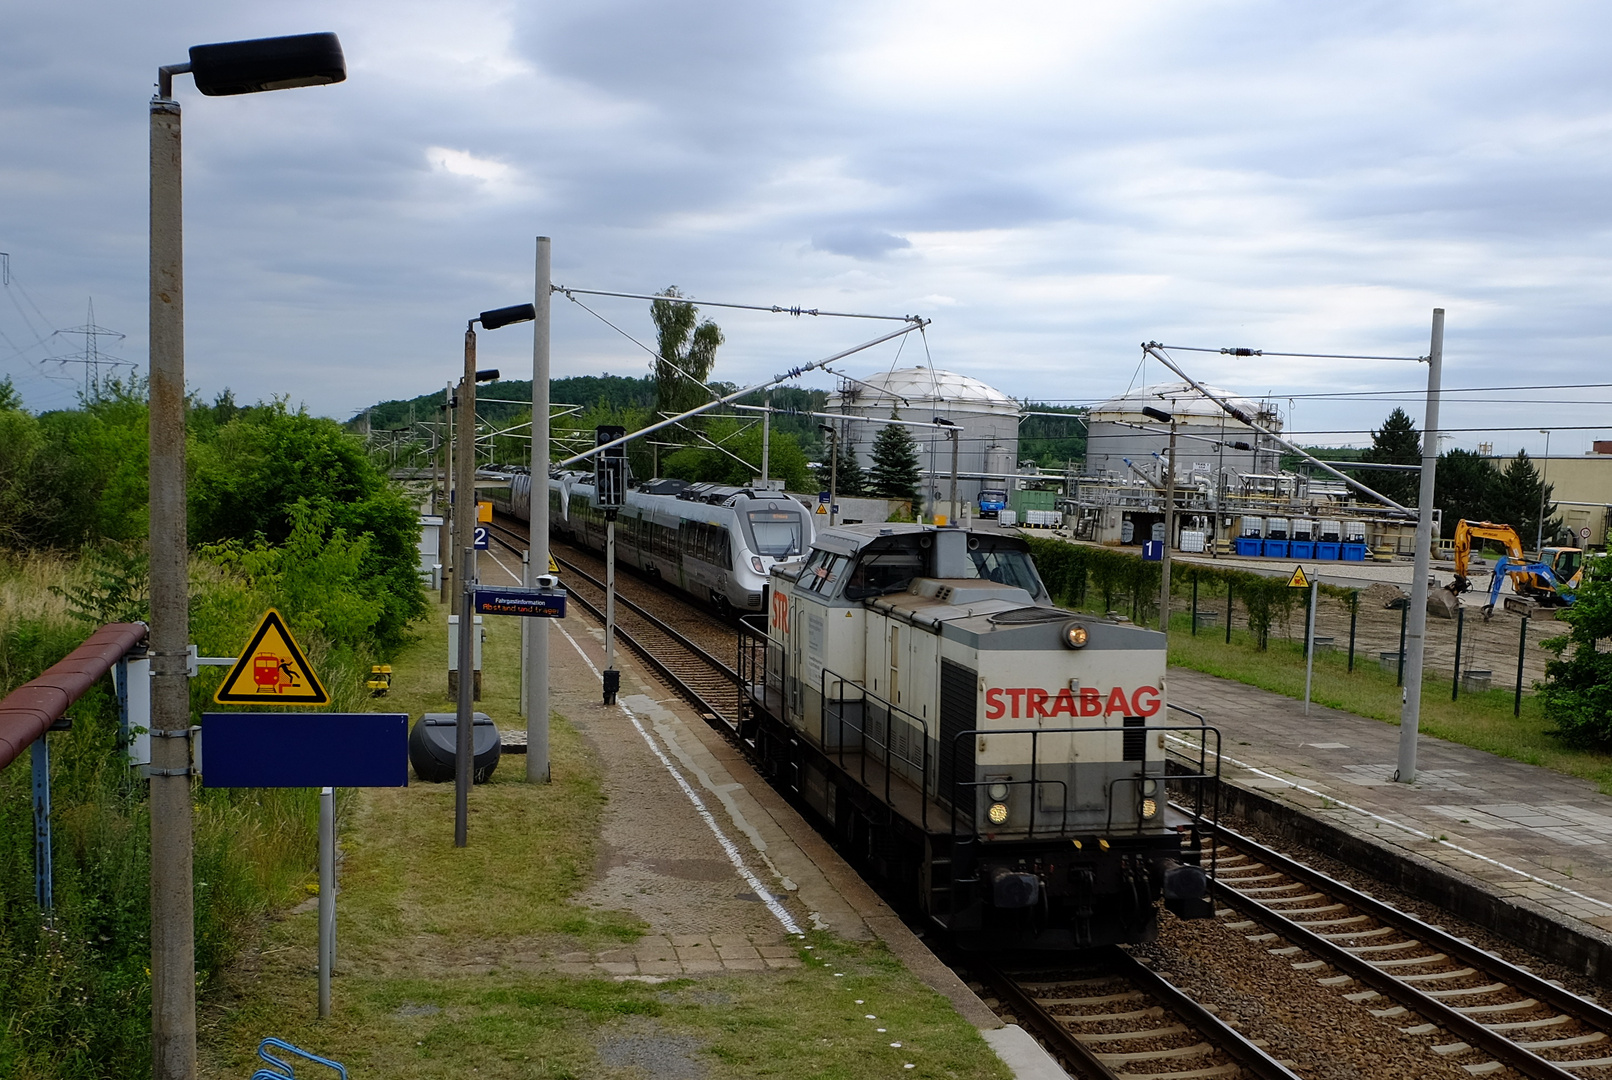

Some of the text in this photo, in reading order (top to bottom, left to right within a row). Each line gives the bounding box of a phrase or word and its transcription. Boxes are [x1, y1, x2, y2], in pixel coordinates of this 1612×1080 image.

[474, 527, 486, 545] 2
[1145, 541, 1153, 557] 1
[517, 605, 533, 613] und
[772, 590, 789, 634] STR
[985, 685, 1162, 720] STRABAG
